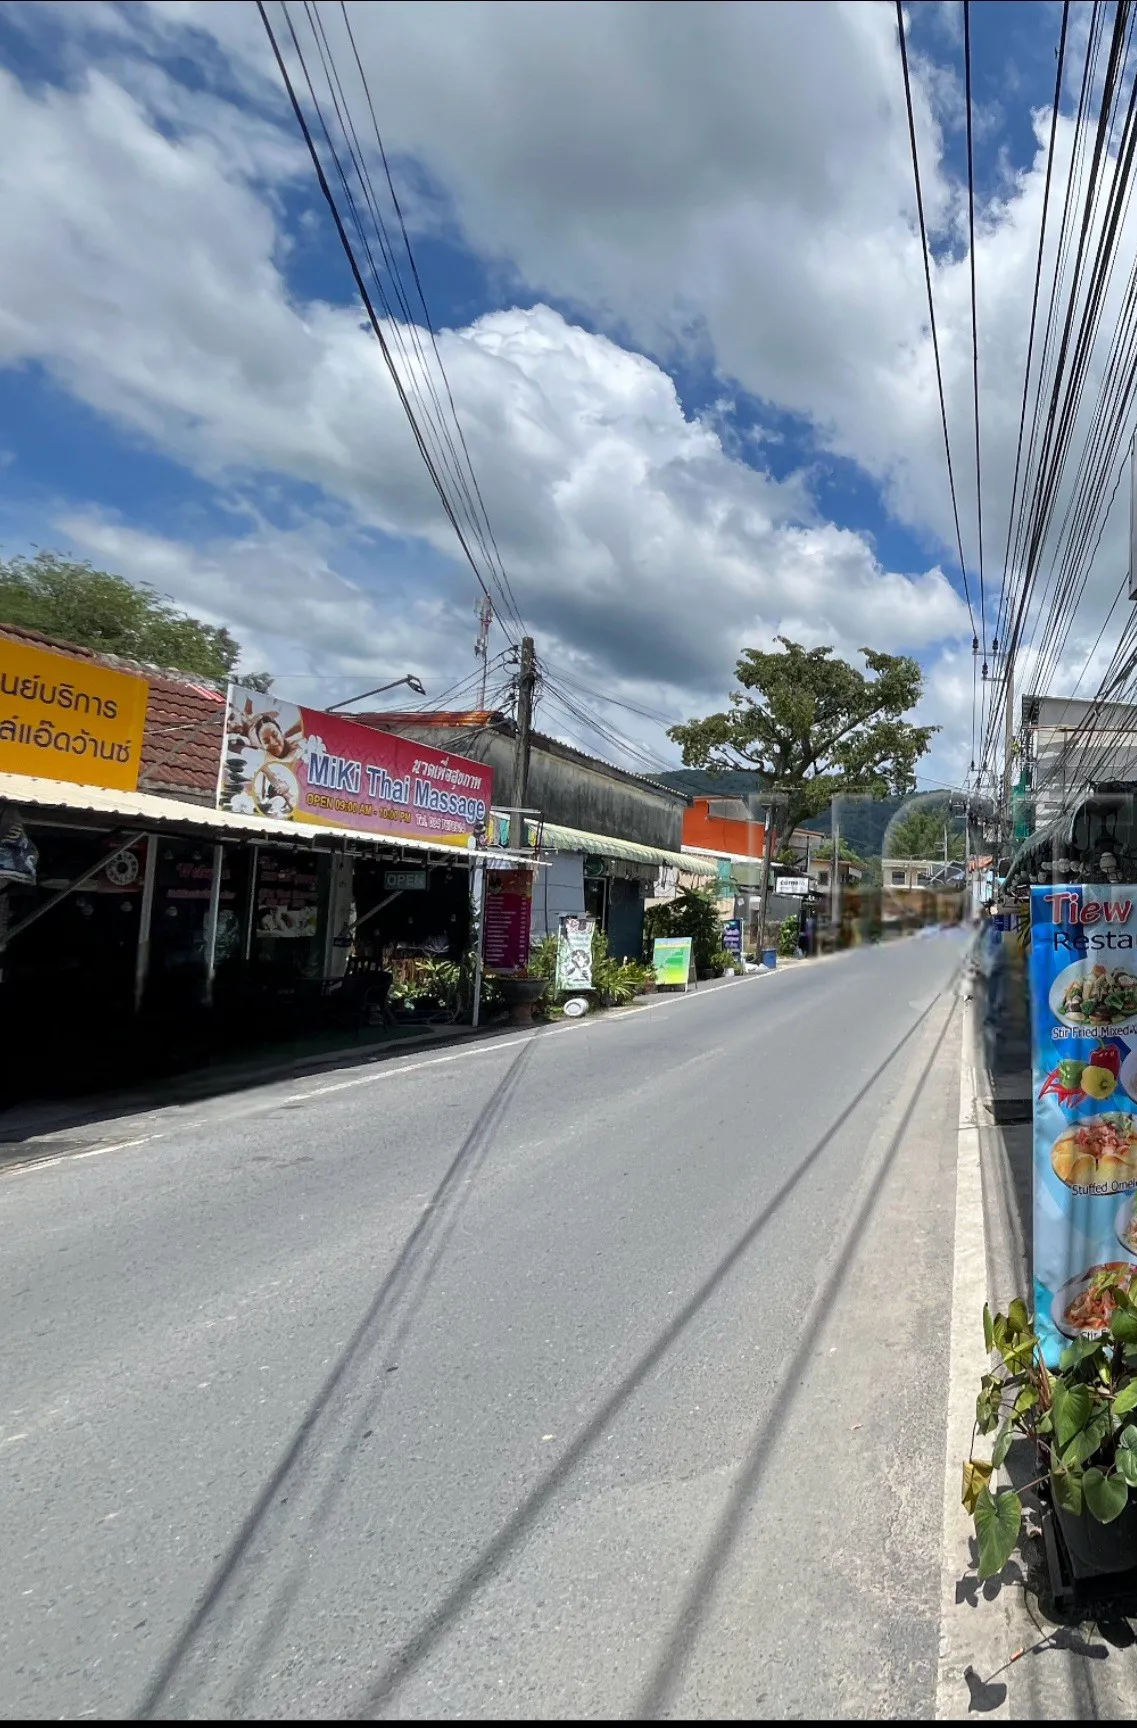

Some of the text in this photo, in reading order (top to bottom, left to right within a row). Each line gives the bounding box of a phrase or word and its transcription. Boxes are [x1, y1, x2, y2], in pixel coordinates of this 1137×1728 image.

[366, 764, 411, 805] Thai
[413, 778, 486, 824] Massage
[307, 793, 333, 808] OPEN
[359, 803, 373, 817] AM
[400, 811, 412, 823] PM
[386, 874, 423, 887] OPEN
[1045, 891, 1132, 925] Tiew
[1052, 1026, 1070, 1039] Stir
[1072, 1025, 1098, 1038] Fried
[1101, 1024, 1130, 1038] Mixed
[1072, 1182, 1108, 1196] Stuffed
